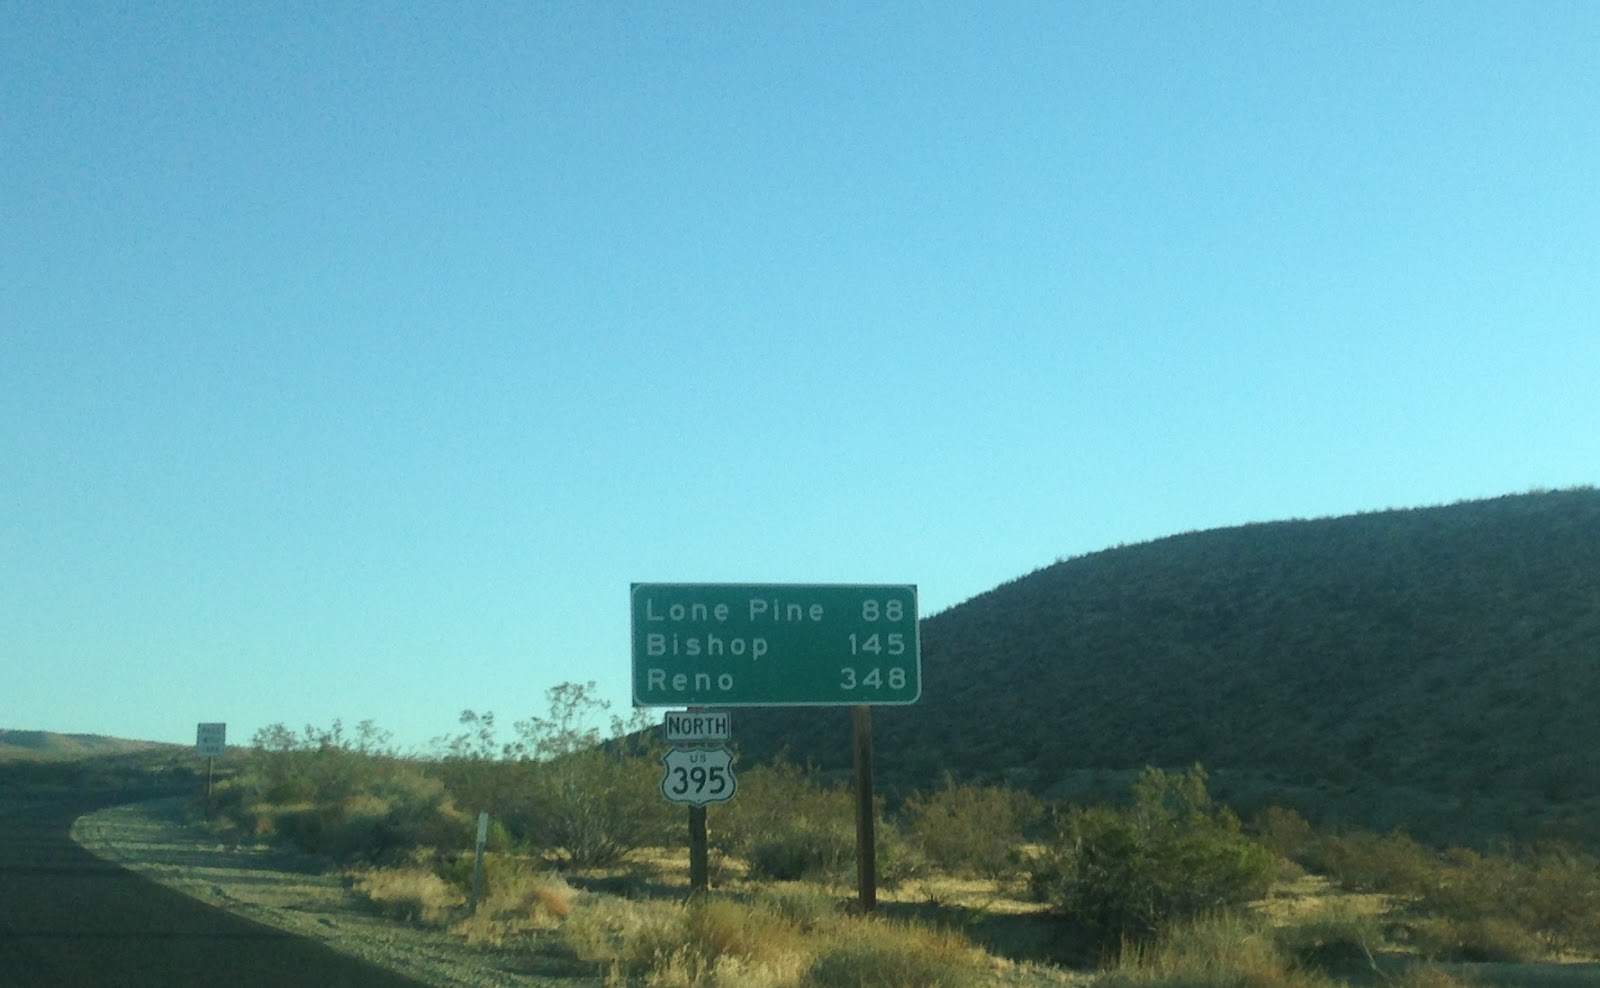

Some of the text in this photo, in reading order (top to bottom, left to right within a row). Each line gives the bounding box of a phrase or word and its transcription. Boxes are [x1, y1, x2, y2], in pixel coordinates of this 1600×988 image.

[646, 598, 904, 622] Lone Pine 88
[646, 633, 905, 661] Bishop 145
[647, 667, 906, 691] Reno 348
[668, 716, 726, 735] NORTH
[689, 754, 707, 764] US
[672, 766, 725, 795] 395
